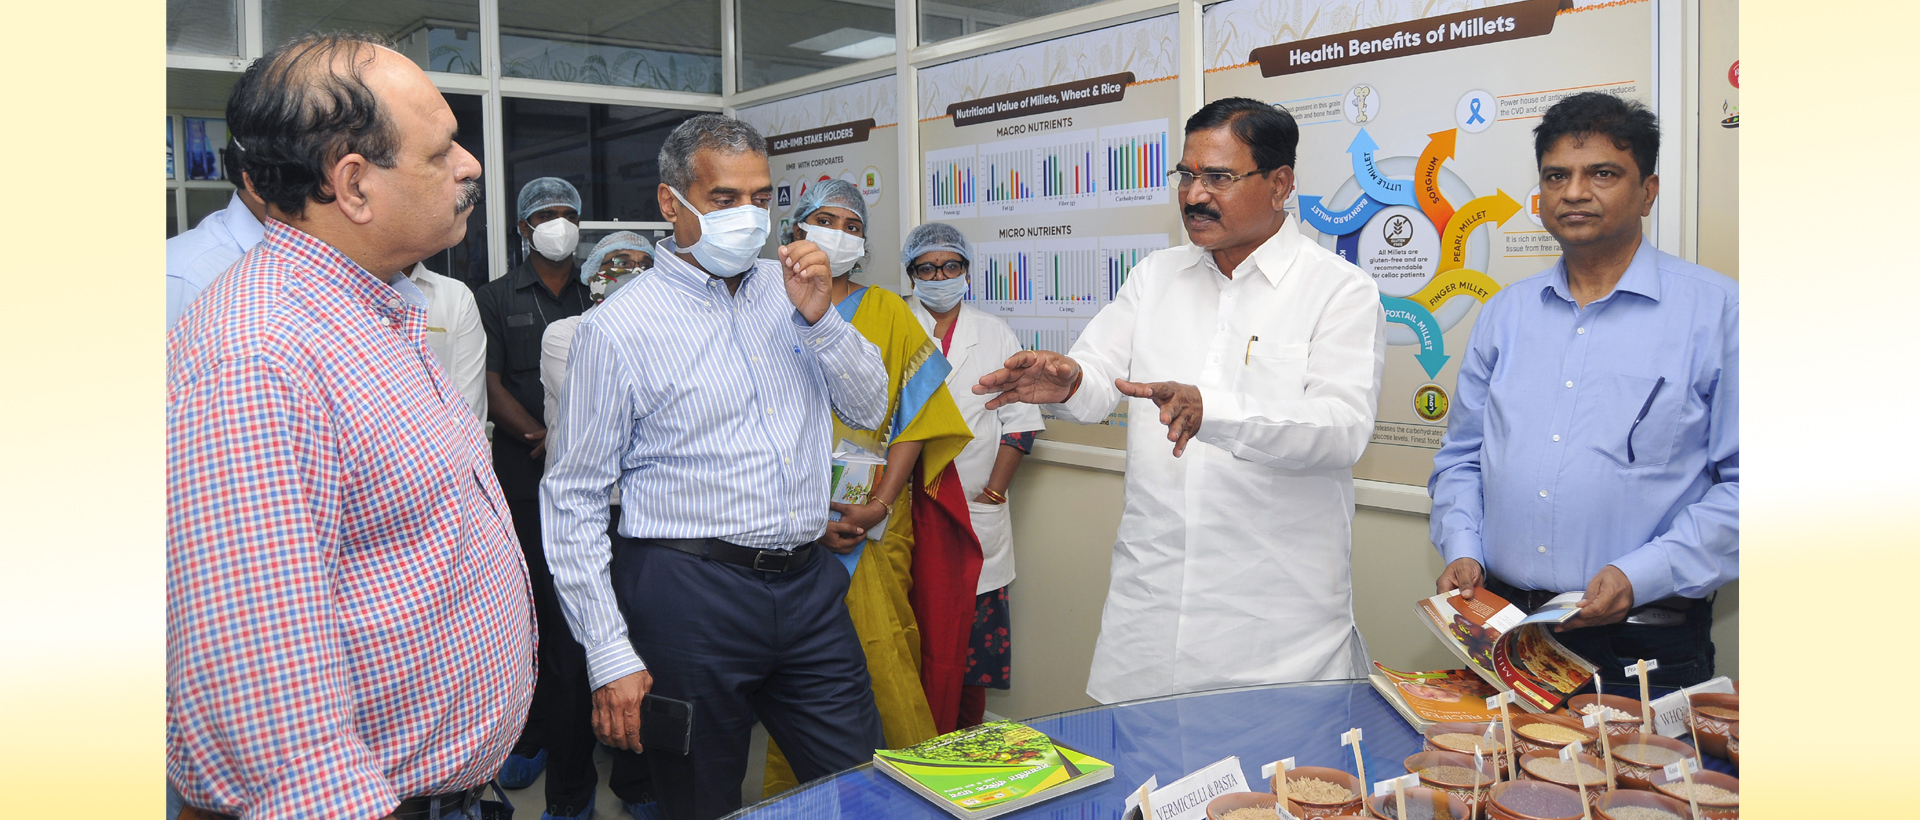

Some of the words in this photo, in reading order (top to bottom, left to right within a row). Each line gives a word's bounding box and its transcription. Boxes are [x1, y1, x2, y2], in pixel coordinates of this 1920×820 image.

[1289, 42, 1344, 66] Health
[1348, 31, 1421, 57] Benefits
[1426, 23, 1446, 44] of
[1450, 15, 1516, 41] Millets
[956, 104, 995, 119] Nutritional
[996, 101, 1019, 113] Value
[1020, 97, 1029, 109] of
[1030, 94, 1059, 107] Millets,
[1061, 87, 1091, 101] Wheat
[1092, 85, 1099, 96] &
[1101, 82, 1121, 95] Rice
[1500, 99, 1519, 107] Power
[1520, 97, 1539, 105] house
[1609, 85, 1636, 95] reduces
[1295, 103, 1312, 112] present
[1319, 101, 1328, 109] this
[1329, 100, 1341, 109] grain
[1314, 110, 1325, 118] bone
[1326, 109, 1341, 117] health
[1510, 107, 1524, 115] CVD
[1525, 105, 1537, 113] and
[996, 124, 1026, 137] MACRO
[1028, 117, 1073, 132] NUTRIENTS
[773, 137, 803, 150] ICAR-IIMR
[803, 133, 823, 146] STAKE
[823, 128, 854, 141] HOLDERS
[798, 161, 811, 169] WITH
[811, 156, 844, 167] CORPORATES
[1363, 152, 1379, 181] MILLET
[1376, 177, 1402, 192] LITTLE
[1425, 156, 1440, 204] SORGHUM
[862, 187, 880, 196] bigbasket
[1115, 194, 1146, 202] Carbohydrate
[1311, 205, 1333, 223] MILLET
[1333, 198, 1369, 224] BARNYARD
[999, 228, 1025, 238] MICRO
[1027, 225, 1072, 237] NUTRIENTS
[1453, 234, 1463, 262] PEARL
[1459, 210, 1487, 232] MILLET
[1429, 283, 1457, 306] FINGER
[1459, 281, 1489, 298] MILLET
[1385, 309, 1417, 324] FOXTAIL
[1417, 320, 1433, 351] MILLET
[1372, 433, 1392, 441] glucose
[1427, 437, 1439, 445] food
[1374, 424, 1395, 432] releases
[1405, 427, 1443, 436] carbohydrates
[1420, 710, 1482, 720] RECIPES
[1660, 706, 1686, 726] WHO
[1667, 766, 1679, 774] Kod
[1155, 787, 1209, 820] VERMICELLI
[1207, 783, 1215, 798] &
[1214, 773, 1238, 795] PASTA
